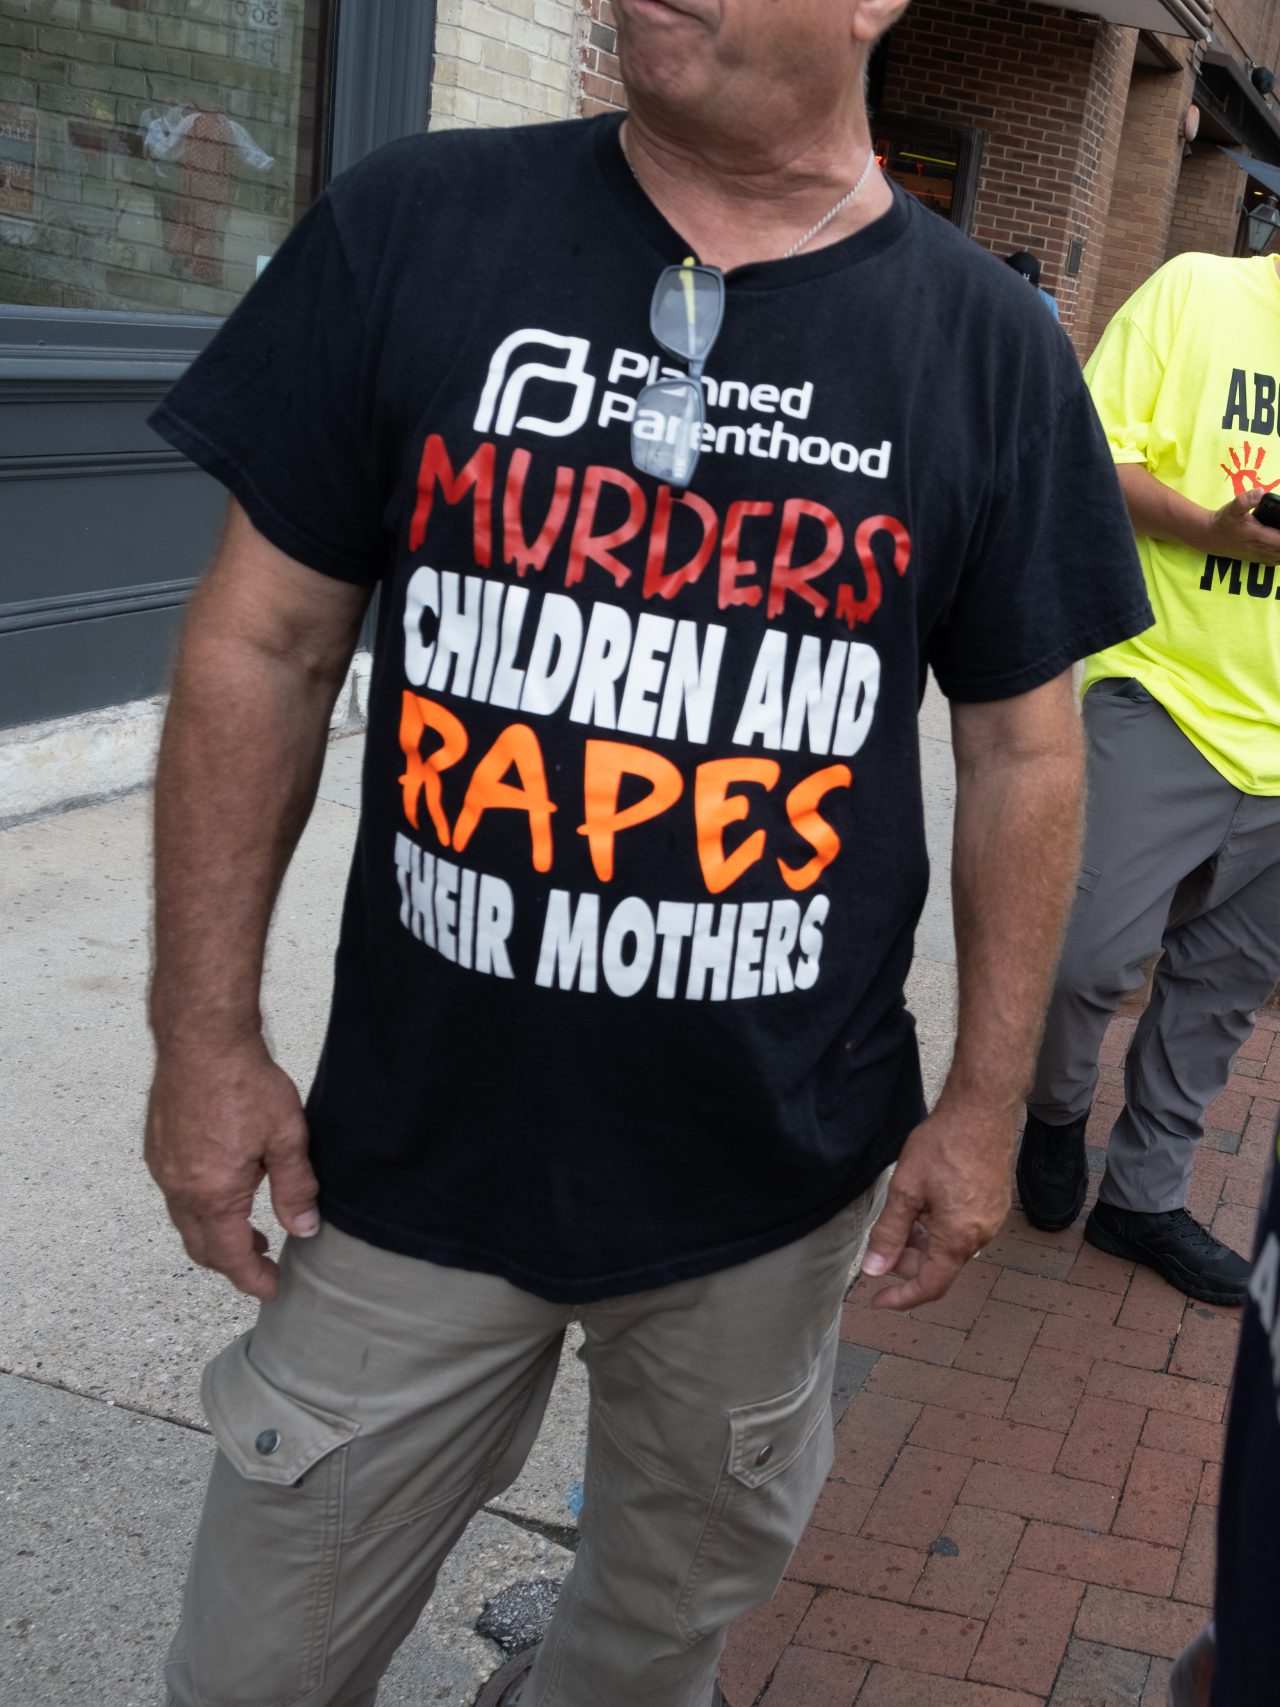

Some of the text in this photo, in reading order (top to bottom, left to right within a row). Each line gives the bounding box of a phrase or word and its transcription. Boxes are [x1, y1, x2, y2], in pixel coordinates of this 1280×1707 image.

[598, 391, 892, 479] Parenthood
[608, 347, 813, 420] Planned
[408, 434, 912, 630] MURDERS
[403, 565, 881, 757] CHILDREN AND
[398, 689, 852, 894] RAPES
[394, 832, 830, 1001] THEIR MOTHERS
